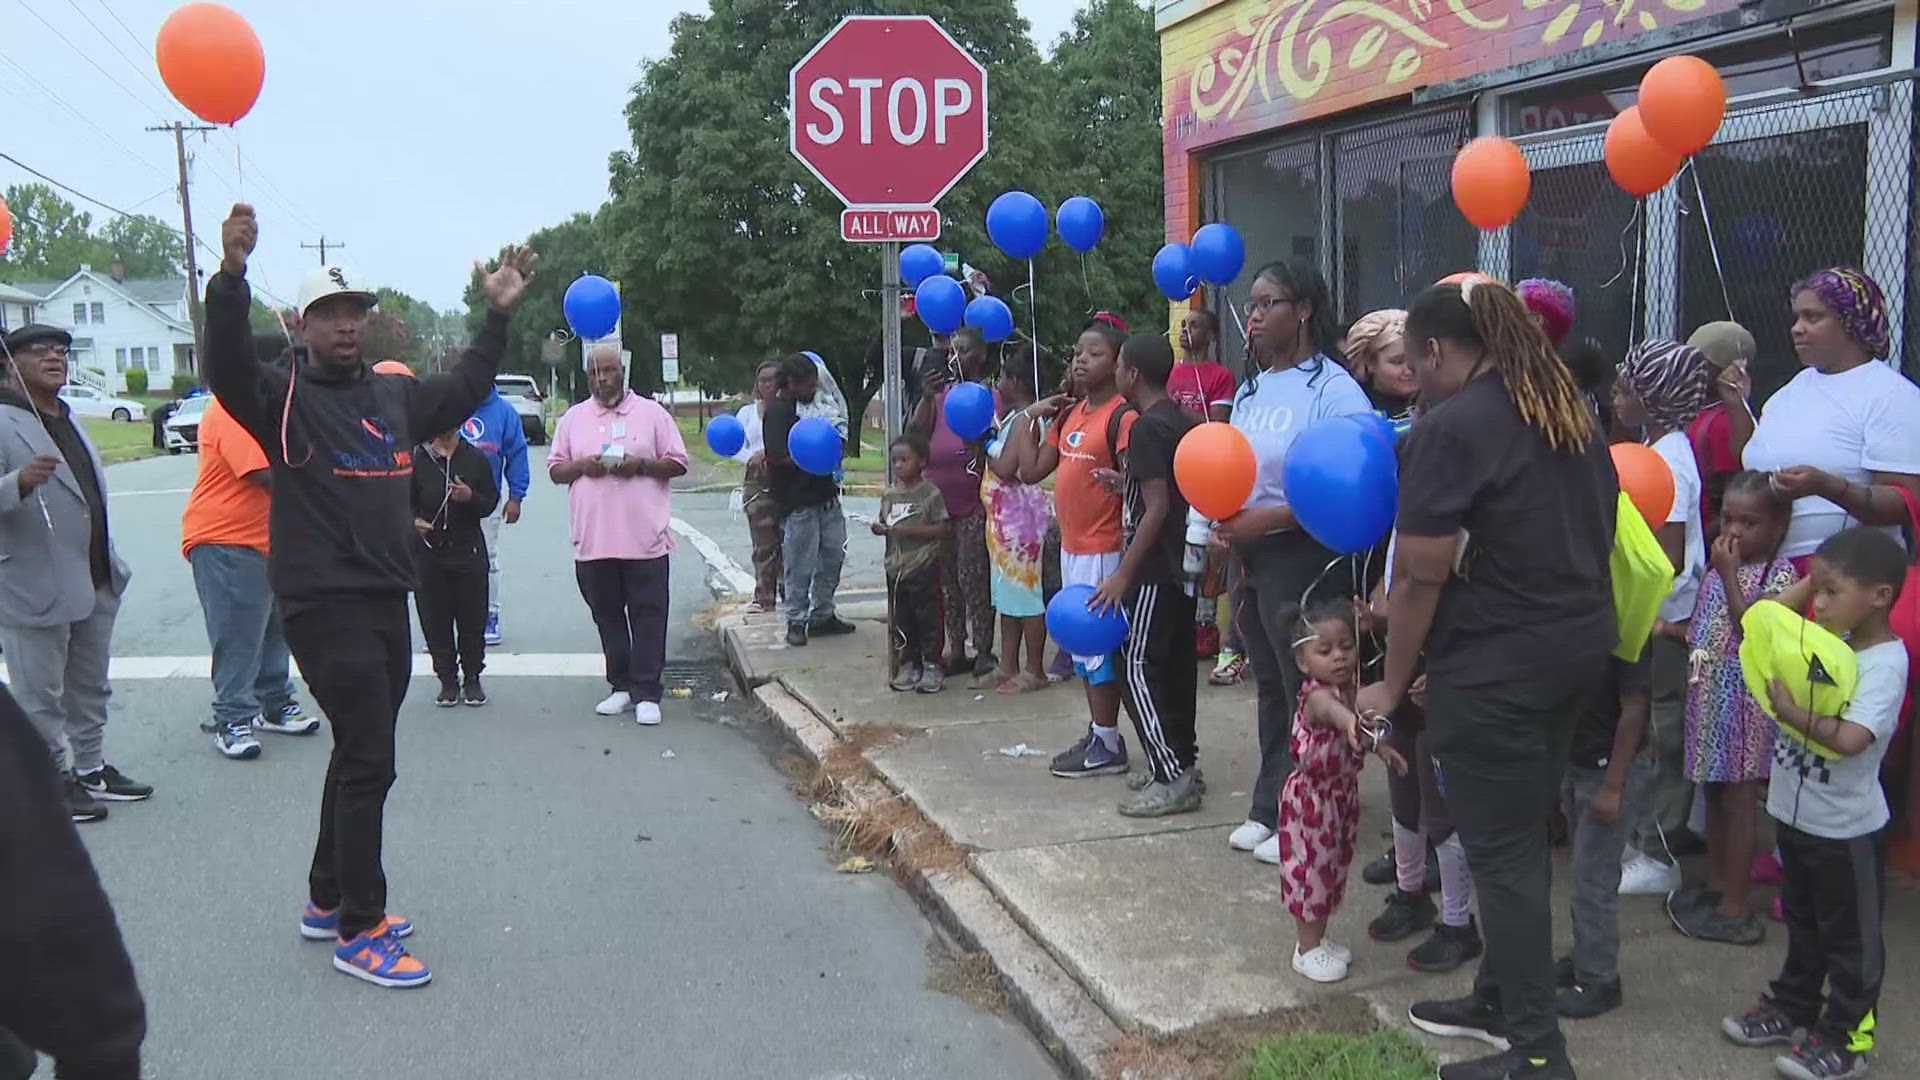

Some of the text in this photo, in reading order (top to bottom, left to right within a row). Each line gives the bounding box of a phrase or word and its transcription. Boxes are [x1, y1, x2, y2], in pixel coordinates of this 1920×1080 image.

[806, 76, 972, 146] STOP
[851, 215, 931, 234] ALL WAY
